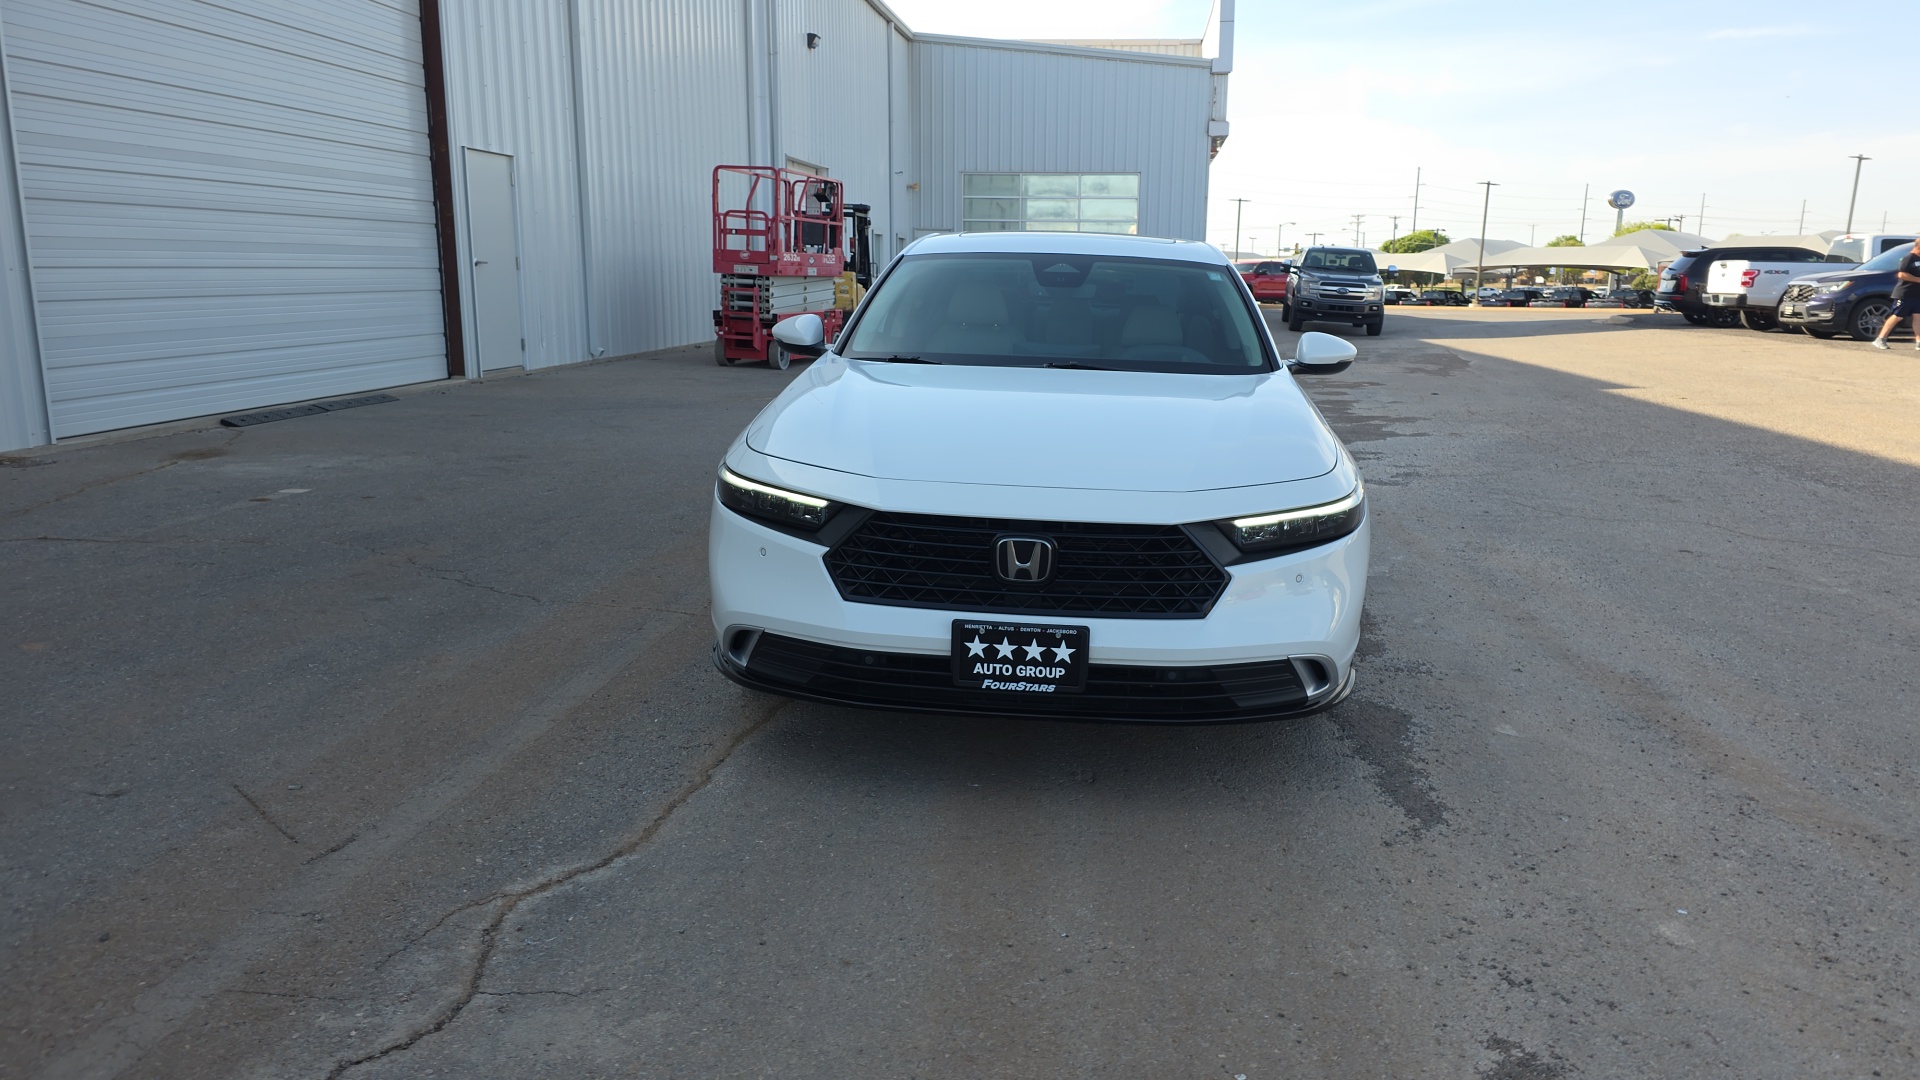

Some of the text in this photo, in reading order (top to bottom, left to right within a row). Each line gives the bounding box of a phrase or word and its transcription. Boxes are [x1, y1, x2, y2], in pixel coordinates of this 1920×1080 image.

[783, 253, 801, 262] 2632
[973, 662, 1066, 679] AUTO GROUP
